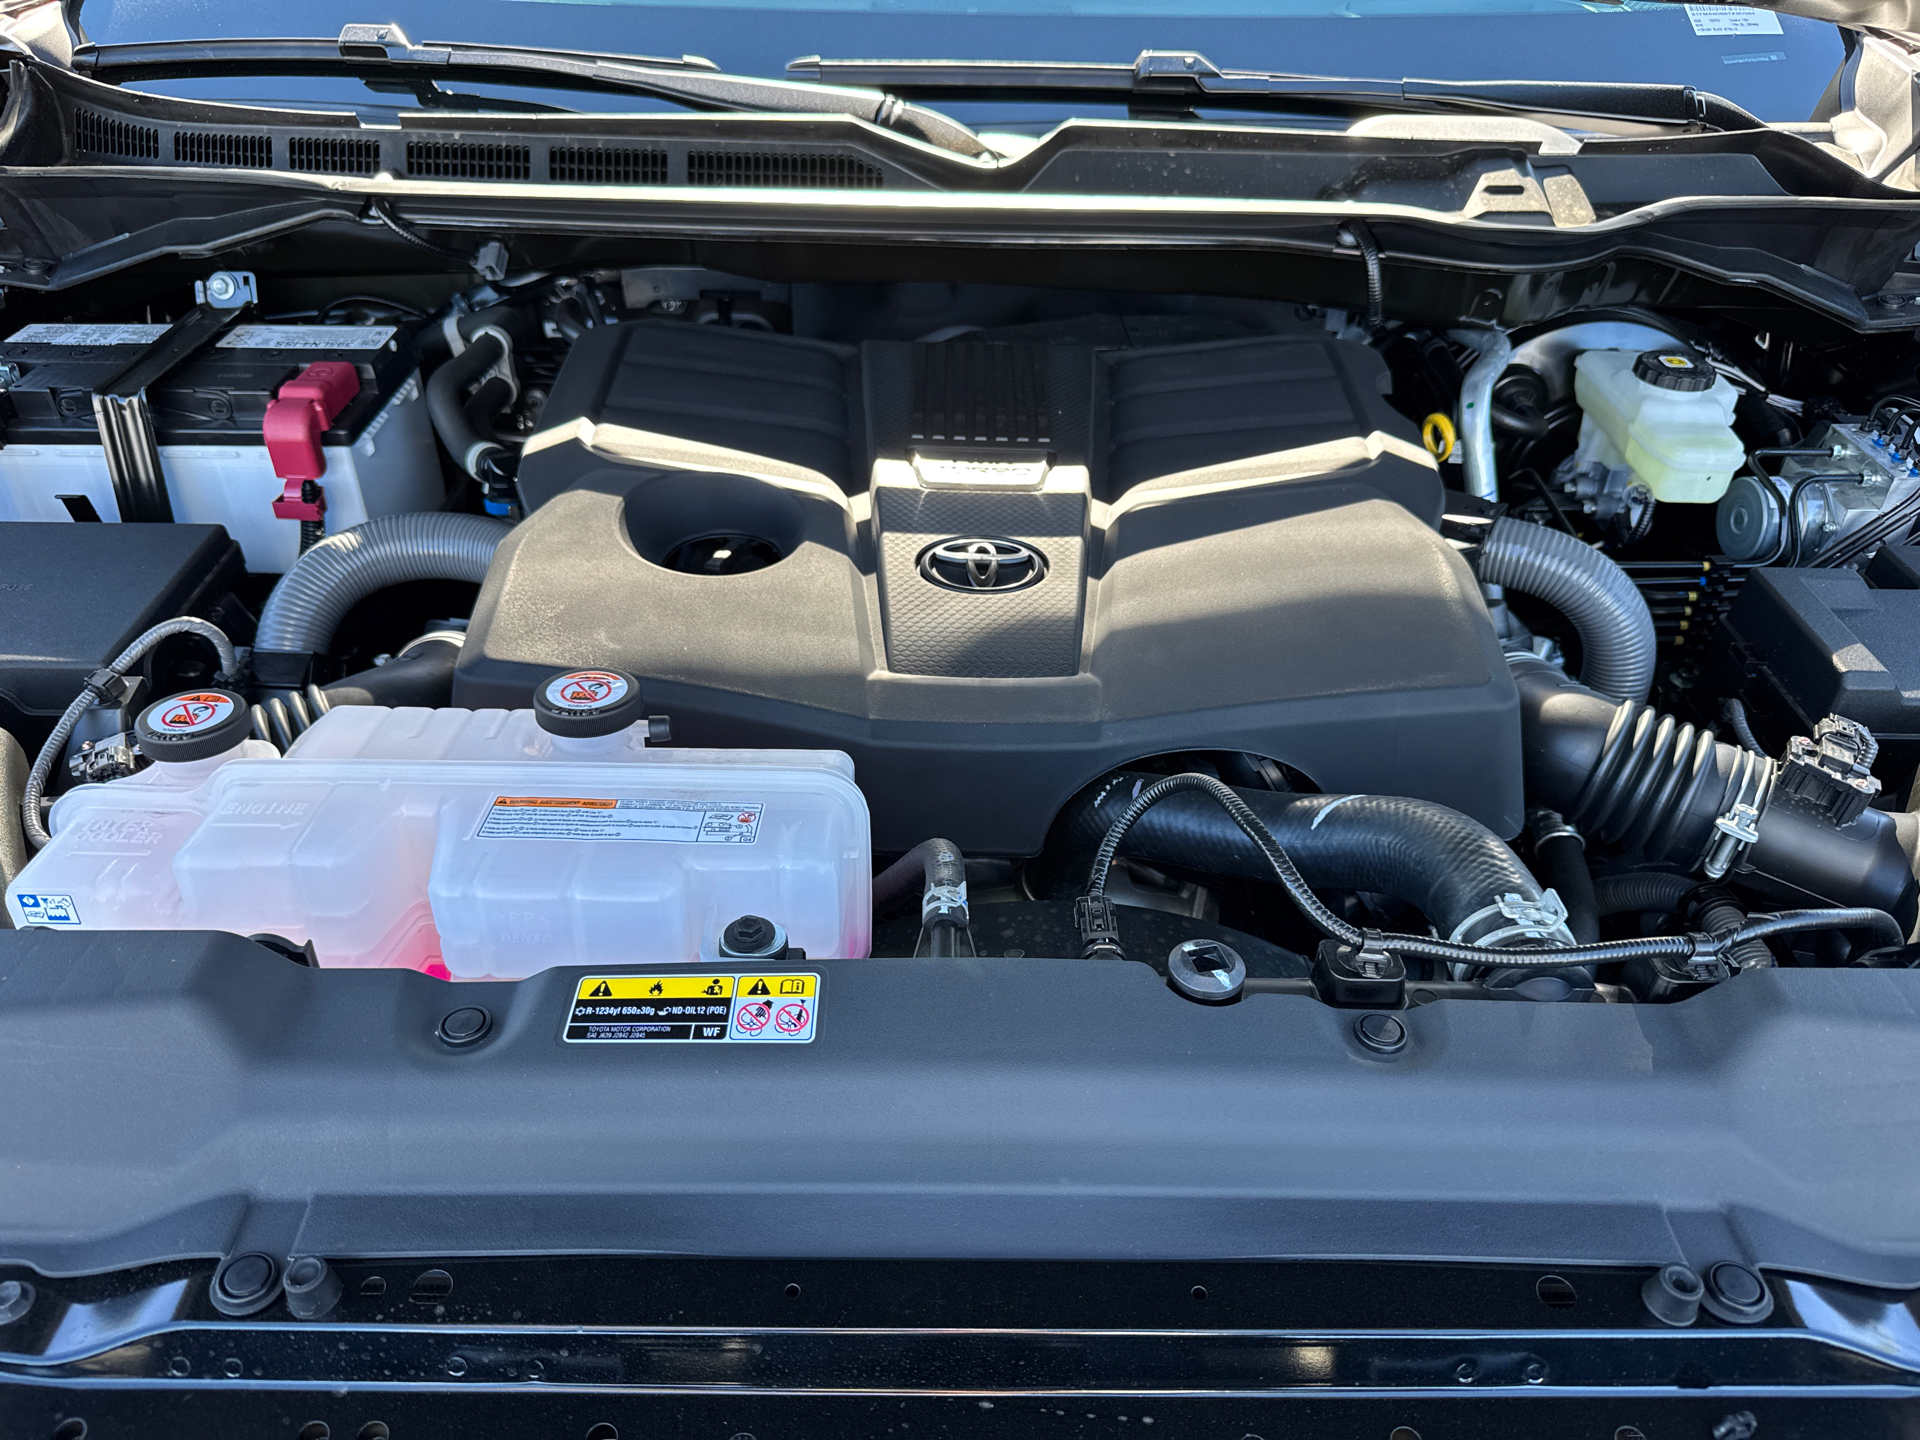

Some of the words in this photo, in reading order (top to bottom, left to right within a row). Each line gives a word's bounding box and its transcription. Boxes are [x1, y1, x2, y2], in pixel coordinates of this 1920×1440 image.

[220, 802, 309, 815] ENGINE
[81, 819, 156, 832] INTER
[74, 831, 163, 844] COOLER
[500, 933, 553, 944] DENSO
[585, 1006, 621, 1016] R-1234yf
[622, 1006, 655, 1016] 650±30g
[706, 1006, 727, 1016] (POE)
[702, 1026, 721, 1037] WF
